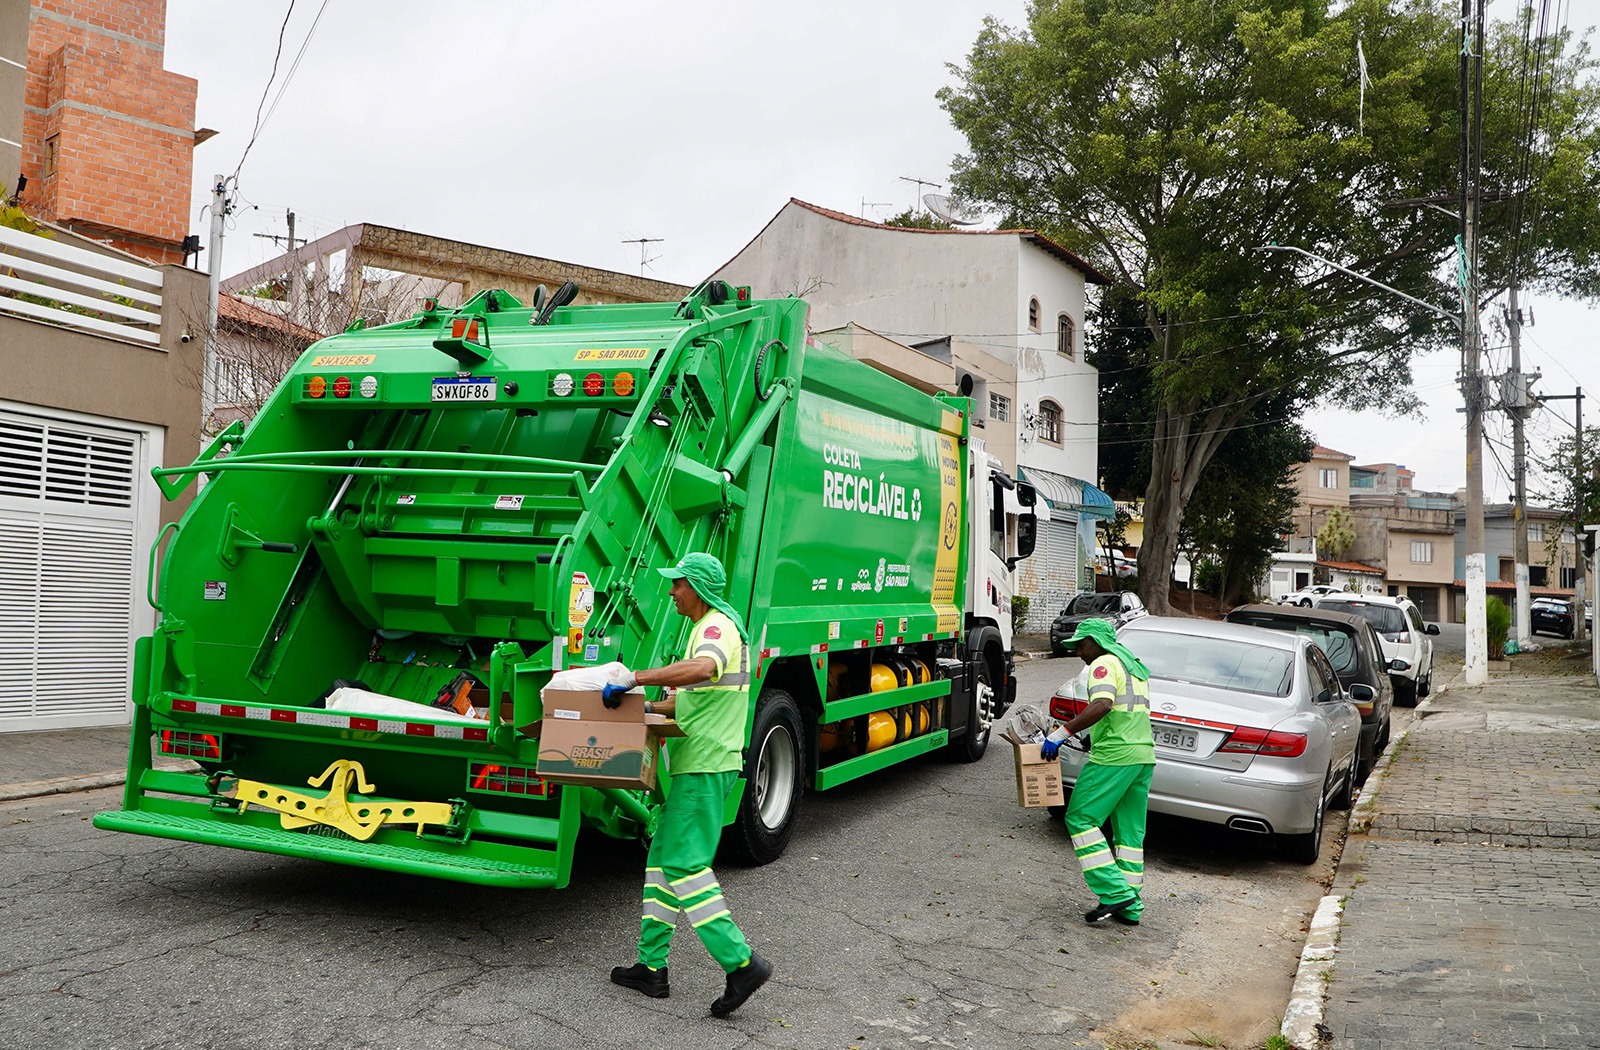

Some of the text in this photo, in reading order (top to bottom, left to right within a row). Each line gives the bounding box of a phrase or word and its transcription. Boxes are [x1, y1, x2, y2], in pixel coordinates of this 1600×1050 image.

[578, 350, 591, 360] SP
[617, 349, 646, 358] PAULO
[824, 443, 861, 470] COLETA
[823, 470, 908, 520] RECICLÁVEL
[571, 746, 612, 760] BRASIL
